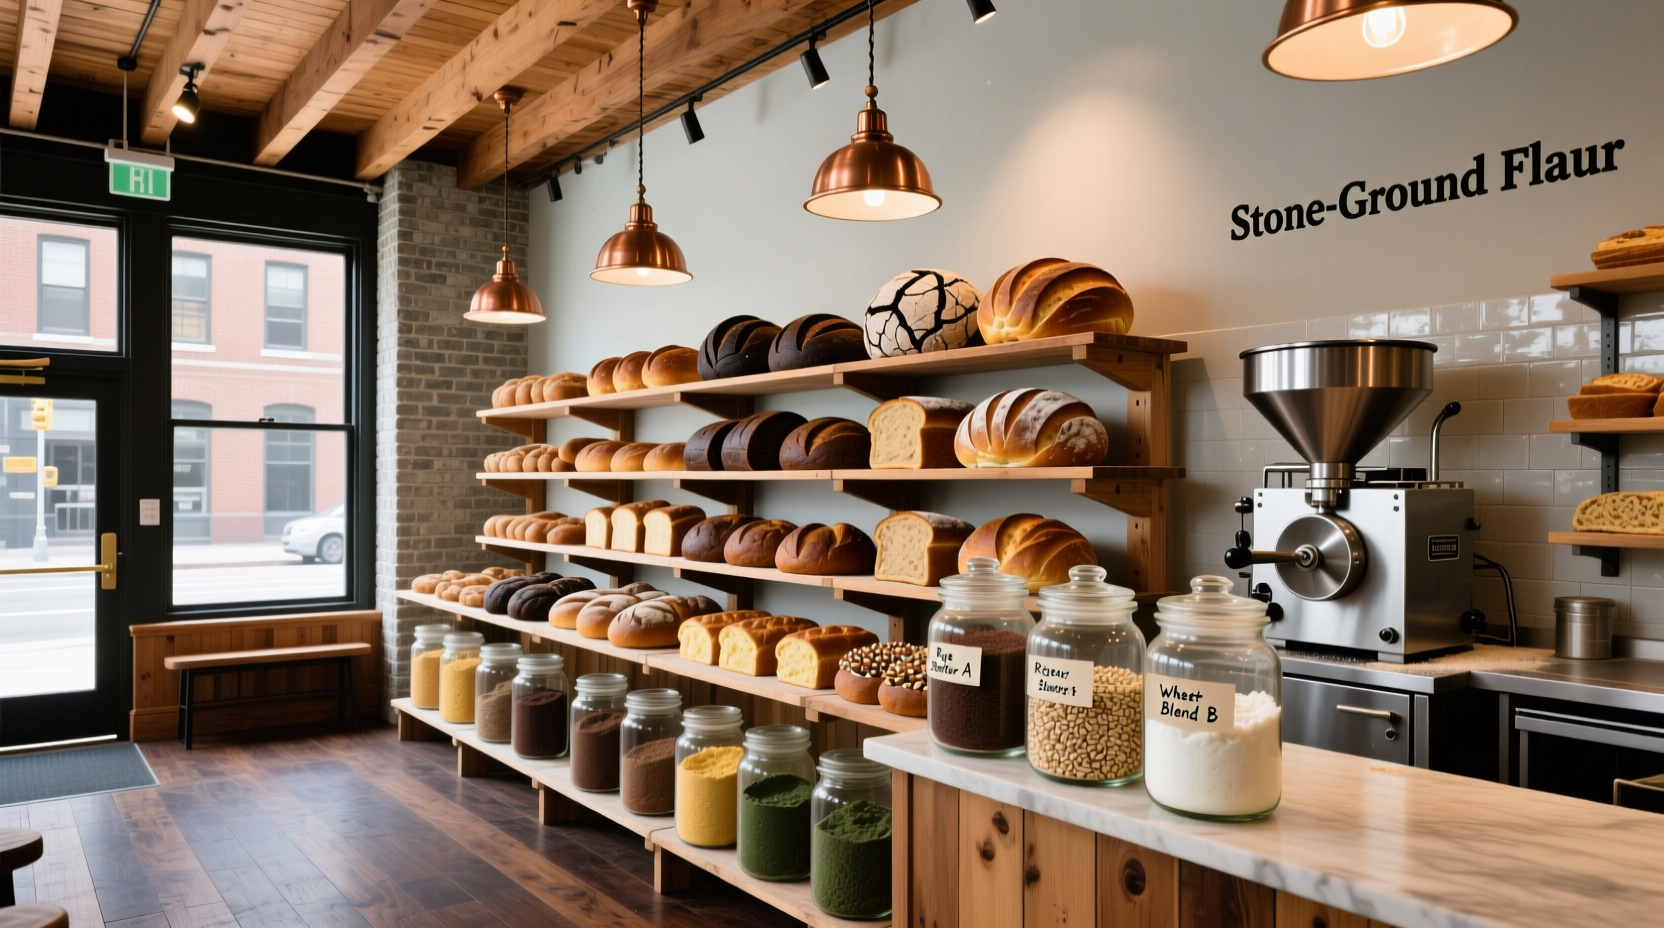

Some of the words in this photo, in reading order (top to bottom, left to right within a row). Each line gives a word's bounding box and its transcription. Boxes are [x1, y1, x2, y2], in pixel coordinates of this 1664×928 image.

[1230, 152, 1489, 241] Stone-Ground
[1500, 138, 1626, 192] Flaur
[961, 661, 972, 679] A
[1160, 700, 1200, 722] Blend
[1206, 706, 1219, 723] B
